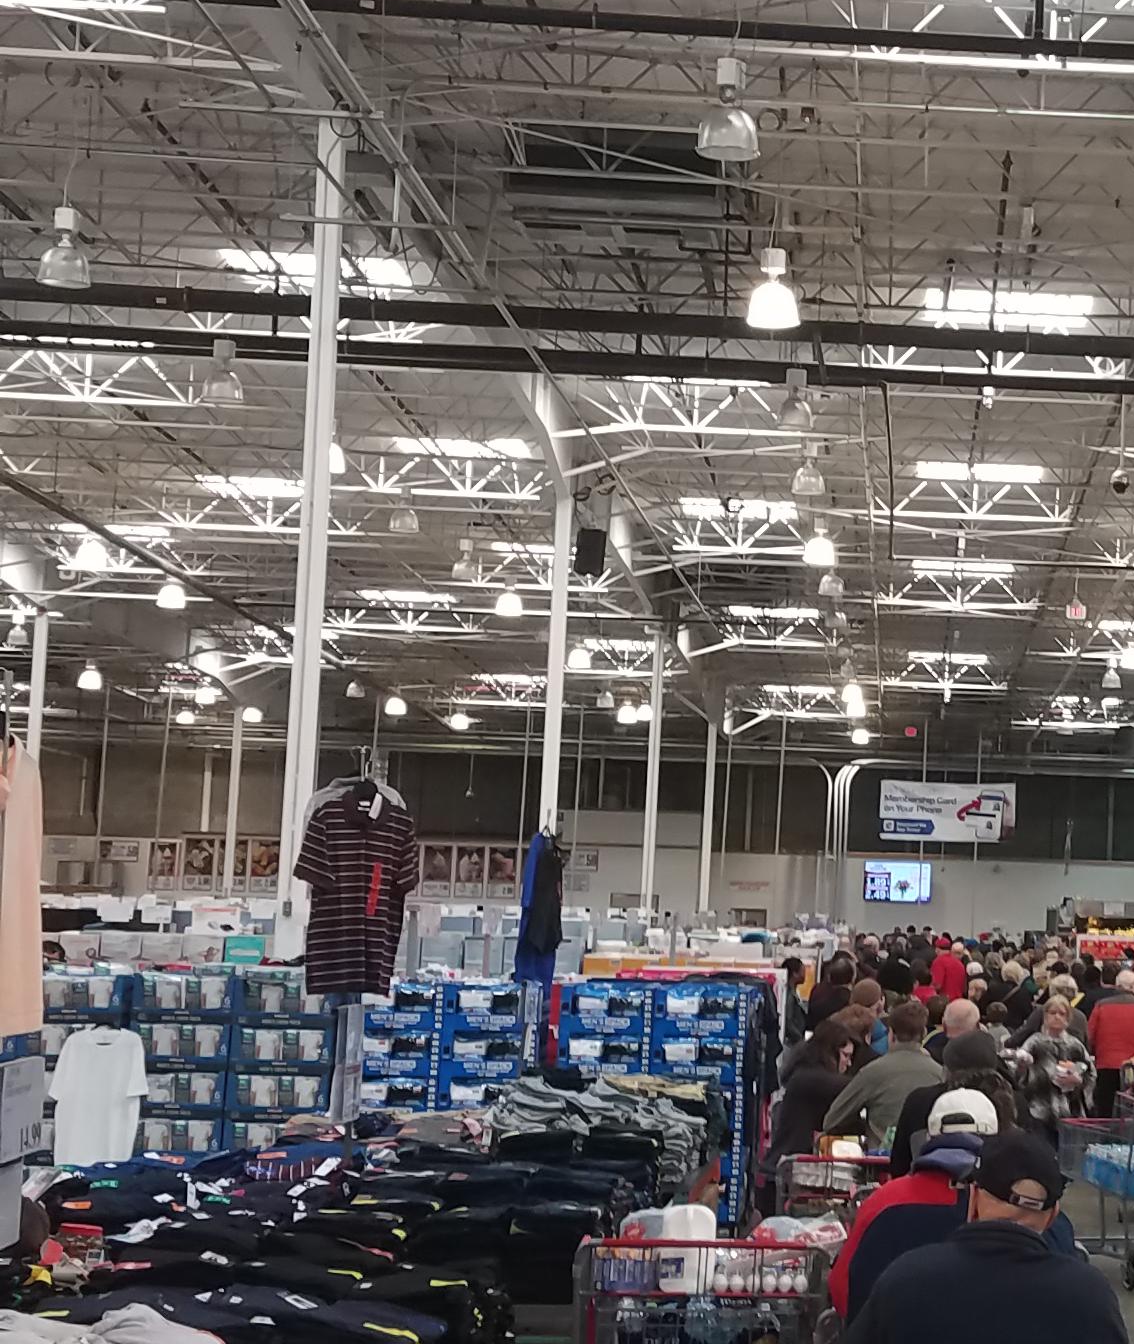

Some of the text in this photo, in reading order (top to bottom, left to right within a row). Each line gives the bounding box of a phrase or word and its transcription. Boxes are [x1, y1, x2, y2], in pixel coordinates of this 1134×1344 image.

[884, 794, 957, 805] Membership Card
[917, 805, 942, 813] Phone
